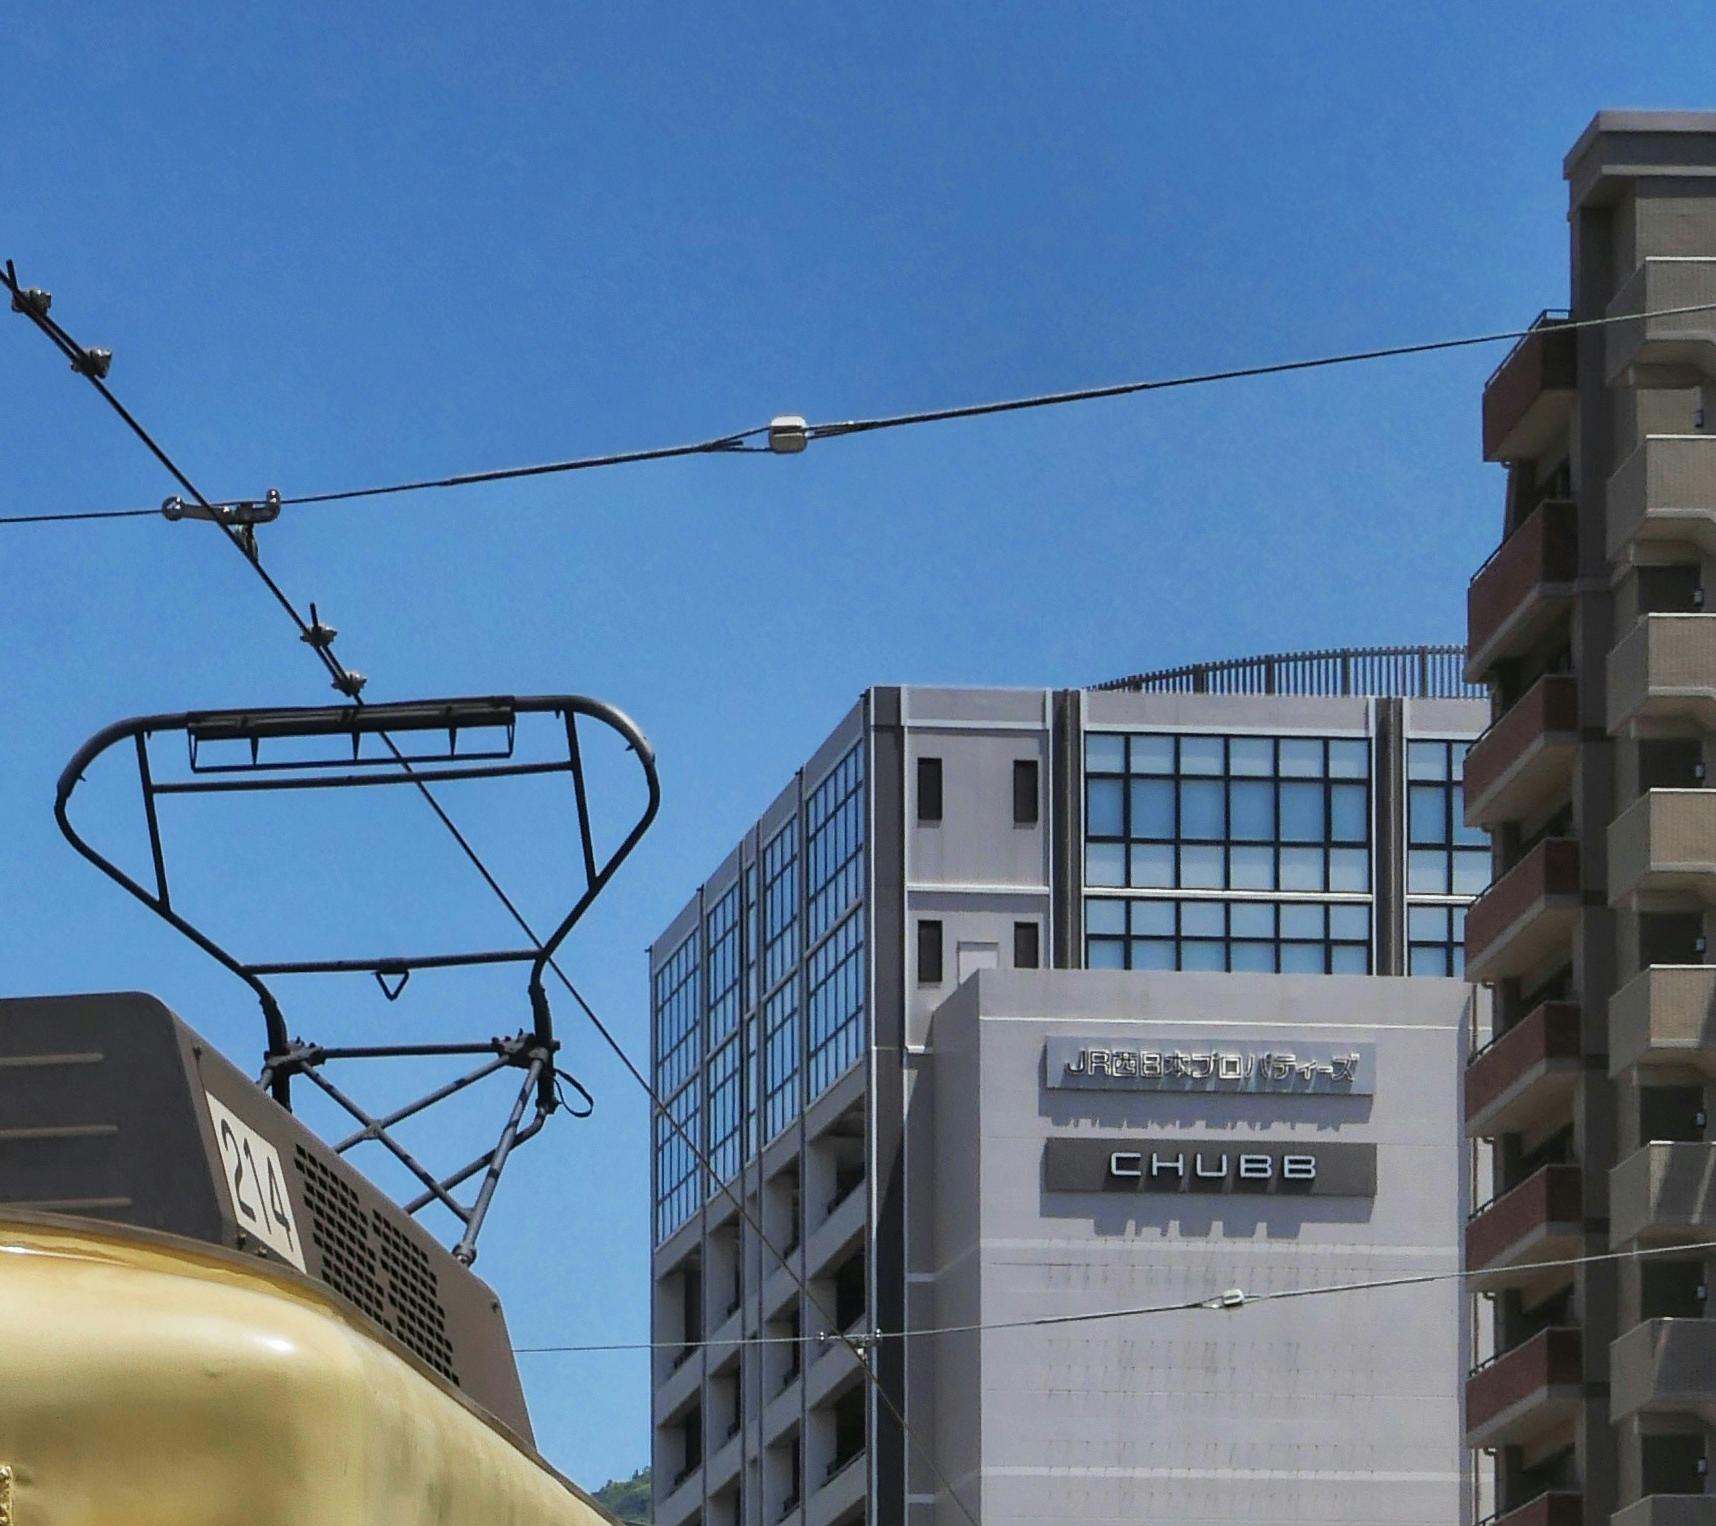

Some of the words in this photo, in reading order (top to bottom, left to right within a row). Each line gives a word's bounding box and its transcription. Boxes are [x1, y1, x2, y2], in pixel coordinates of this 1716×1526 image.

[1065, 1048, 1360, 1082] JR西日本プロパティーズ
[1110, 1151, 1317, 1180] CHUBB
[220, 1117, 295, 1253] 214
